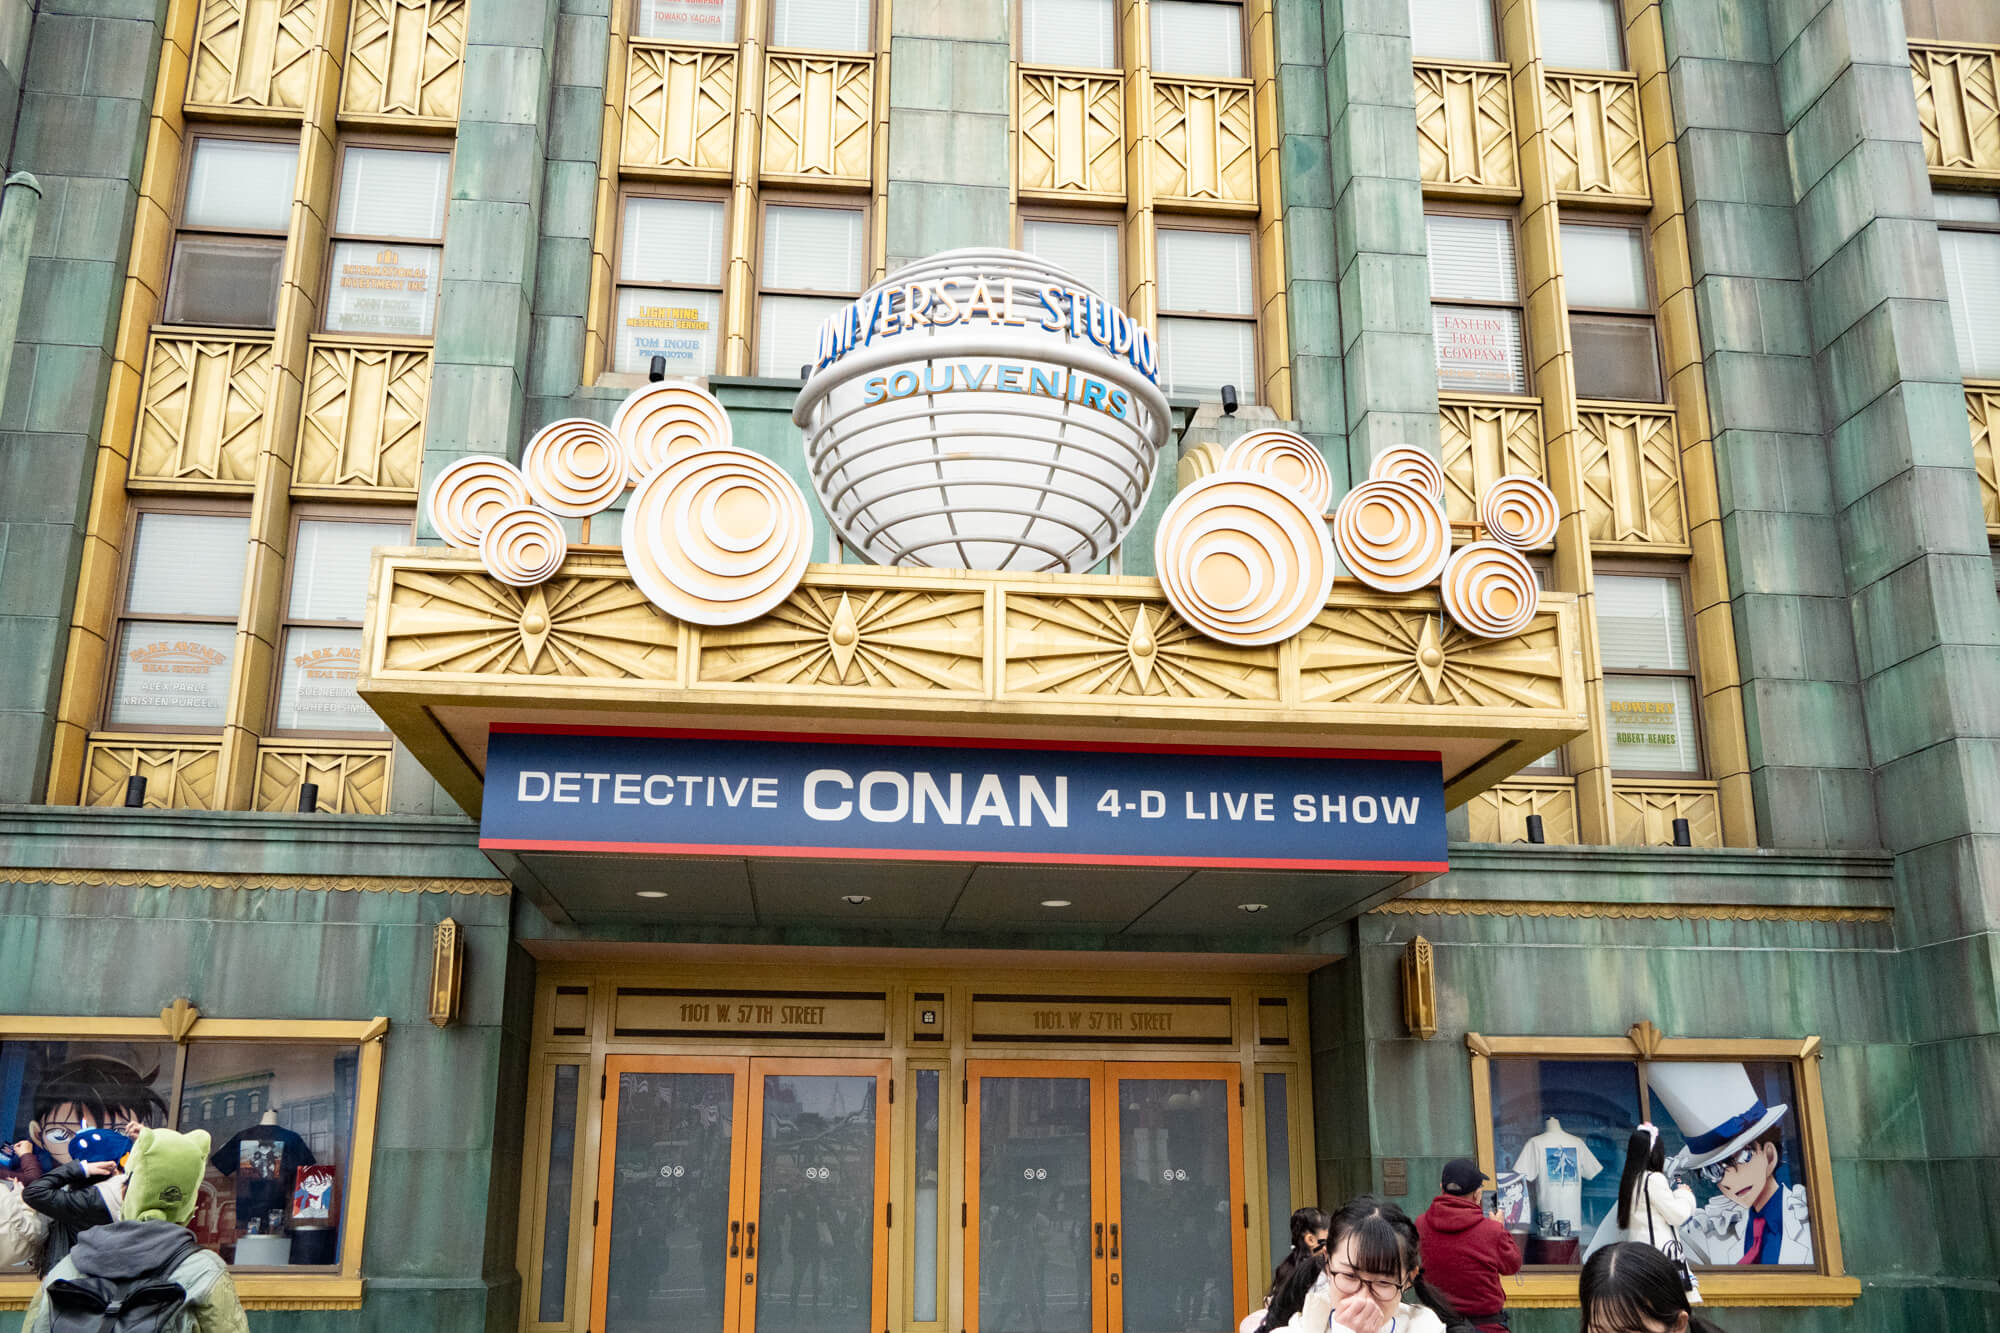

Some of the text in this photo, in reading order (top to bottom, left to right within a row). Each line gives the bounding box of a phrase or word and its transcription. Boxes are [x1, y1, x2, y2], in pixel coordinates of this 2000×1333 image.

[655, 11, 721, 24] TOWAKO YAGURA
[343, 264, 428, 279] INTERNATIONAL
[340, 277, 404, 290] INVESTMENT
[640, 306, 699, 320] LIGHTNING
[626, 318, 709, 330] MESSENGER SERVICE
[816, 274, 1029, 369] UNIVERSAL
[1442, 315, 1501, 331] EASTERN
[635, 337, 700, 350] TOM INOUE
[1451, 331, 1496, 346] TRAVEL
[1442, 345, 1505, 361] COMPANY
[863, 363, 1129, 421] SOUVENIRS
[129, 641, 227, 665] PARK AVENUE
[294, 647, 332, 668] PARK
[142, 663, 209, 674] REAL ESTATE
[307, 670, 332, 680] REAL
[142, 681, 169, 692] ALEX
[122, 696, 169, 706] KRISTEN
[1610, 701, 1674, 714] BOWERY
[1616, 732, 1676, 745] ROBERT REAVES
[518, 769, 1420, 827] DETECTIVE CONAN 4-D LIVE SHOW
[680, 1003, 710, 1023] 1101
[716, 1003, 731, 1023] W.
[781, 1005, 825, 1025] STREET
[1130, 1012, 1173, 1031] STREET
